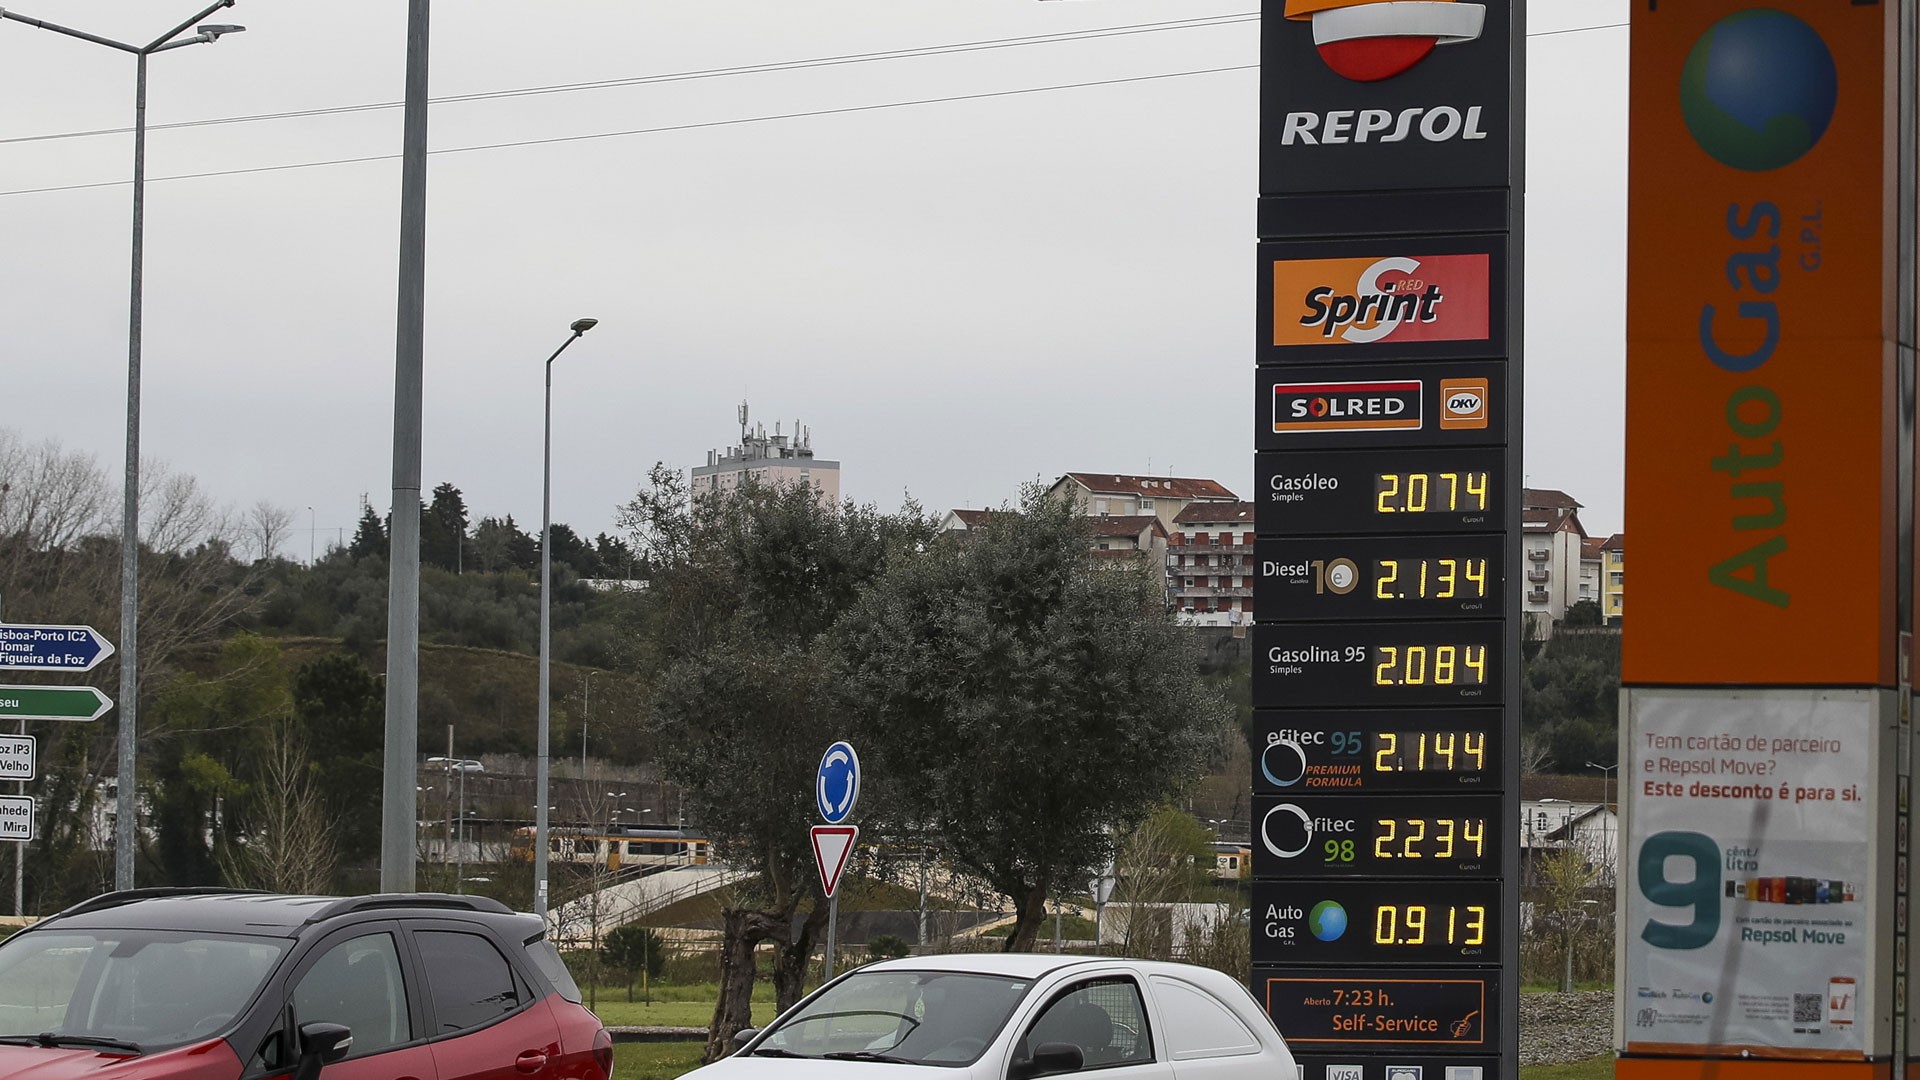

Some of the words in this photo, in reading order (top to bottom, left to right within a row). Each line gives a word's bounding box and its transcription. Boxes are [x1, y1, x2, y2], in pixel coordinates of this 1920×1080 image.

[1281, 106, 1487, 145] REPSOL
[1398, 279, 1424, 291] RED
[1300, 283, 1443, 337] Sprint
[1291, 397, 1405, 418] SOLRED
[1450, 398, 1477, 409] DKV
[1270, 473, 1338, 490] Gasóleo
[1271, 492, 1304, 503] Simples
[1377, 472, 1487, 513] 2.074
[1263, 560, 1309, 576] Diesel
[1376, 558, 1486, 599] 2.134
[67, 631, 87, 642] IC2
[0, 641, 35, 652] Tomar
[1268, 646, 1340, 662] Gasolina
[1345, 646, 1366, 662] 95
[0, 652, 44, 664] Figueira
[47, 653, 61, 664] da
[64, 654, 85, 665] Foz
[1376, 645, 1485, 685] 2.084
[1270, 665, 1302, 675] Simples
[13, 744, 30, 755] IP3
[1267, 729, 1325, 745] efitec
[1331, 731, 1362, 755] 95
[1645, 732, 1682, 749] Tem
[1687, 733, 1741, 751] cartão
[1746, 734, 1767, 751] de
[1772, 736, 1841, 755] parceiro
[1375, 732, 1484, 771] 2.144
[0, 760, 29, 771] Velho
[1305, 765, 1361, 775] PREMIUM
[1644, 759, 1654, 773] e
[1659, 757, 1716, 777] Repsol
[1721, 758, 1777, 775] Move?
[1305, 778, 1362, 787] FORMULA
[1644, 780, 1684, 797] Este
[1689, 780, 1773, 799] desconto
[1779, 781, 1789, 800] é
[1795, 786, 1836, 804] para
[1842, 784, 1862, 801] si.
[3, 821, 28, 833] Mira
[1375, 819, 1484, 858] 2.234
[1324, 840, 1355, 861] 98
[1726, 858, 1759, 871] litro
[1638, 831, 1722, 950] 9
[1265, 904, 1303, 920] Auto
[1265, 922, 1295, 938] Gas
[1375, 905, 1485, 945] 0.913
[1742, 927, 1798, 946] Repsol
[1803, 928, 1846, 944] Move
[1304, 997, 1331, 1006] Aberto
[1333, 990, 1373, 1006] 7:23
[1378, 989, 1394, 1006] h.
[1333, 1015, 1438, 1031] Self-Service
[1333, 1070, 1360, 1080] VISA
